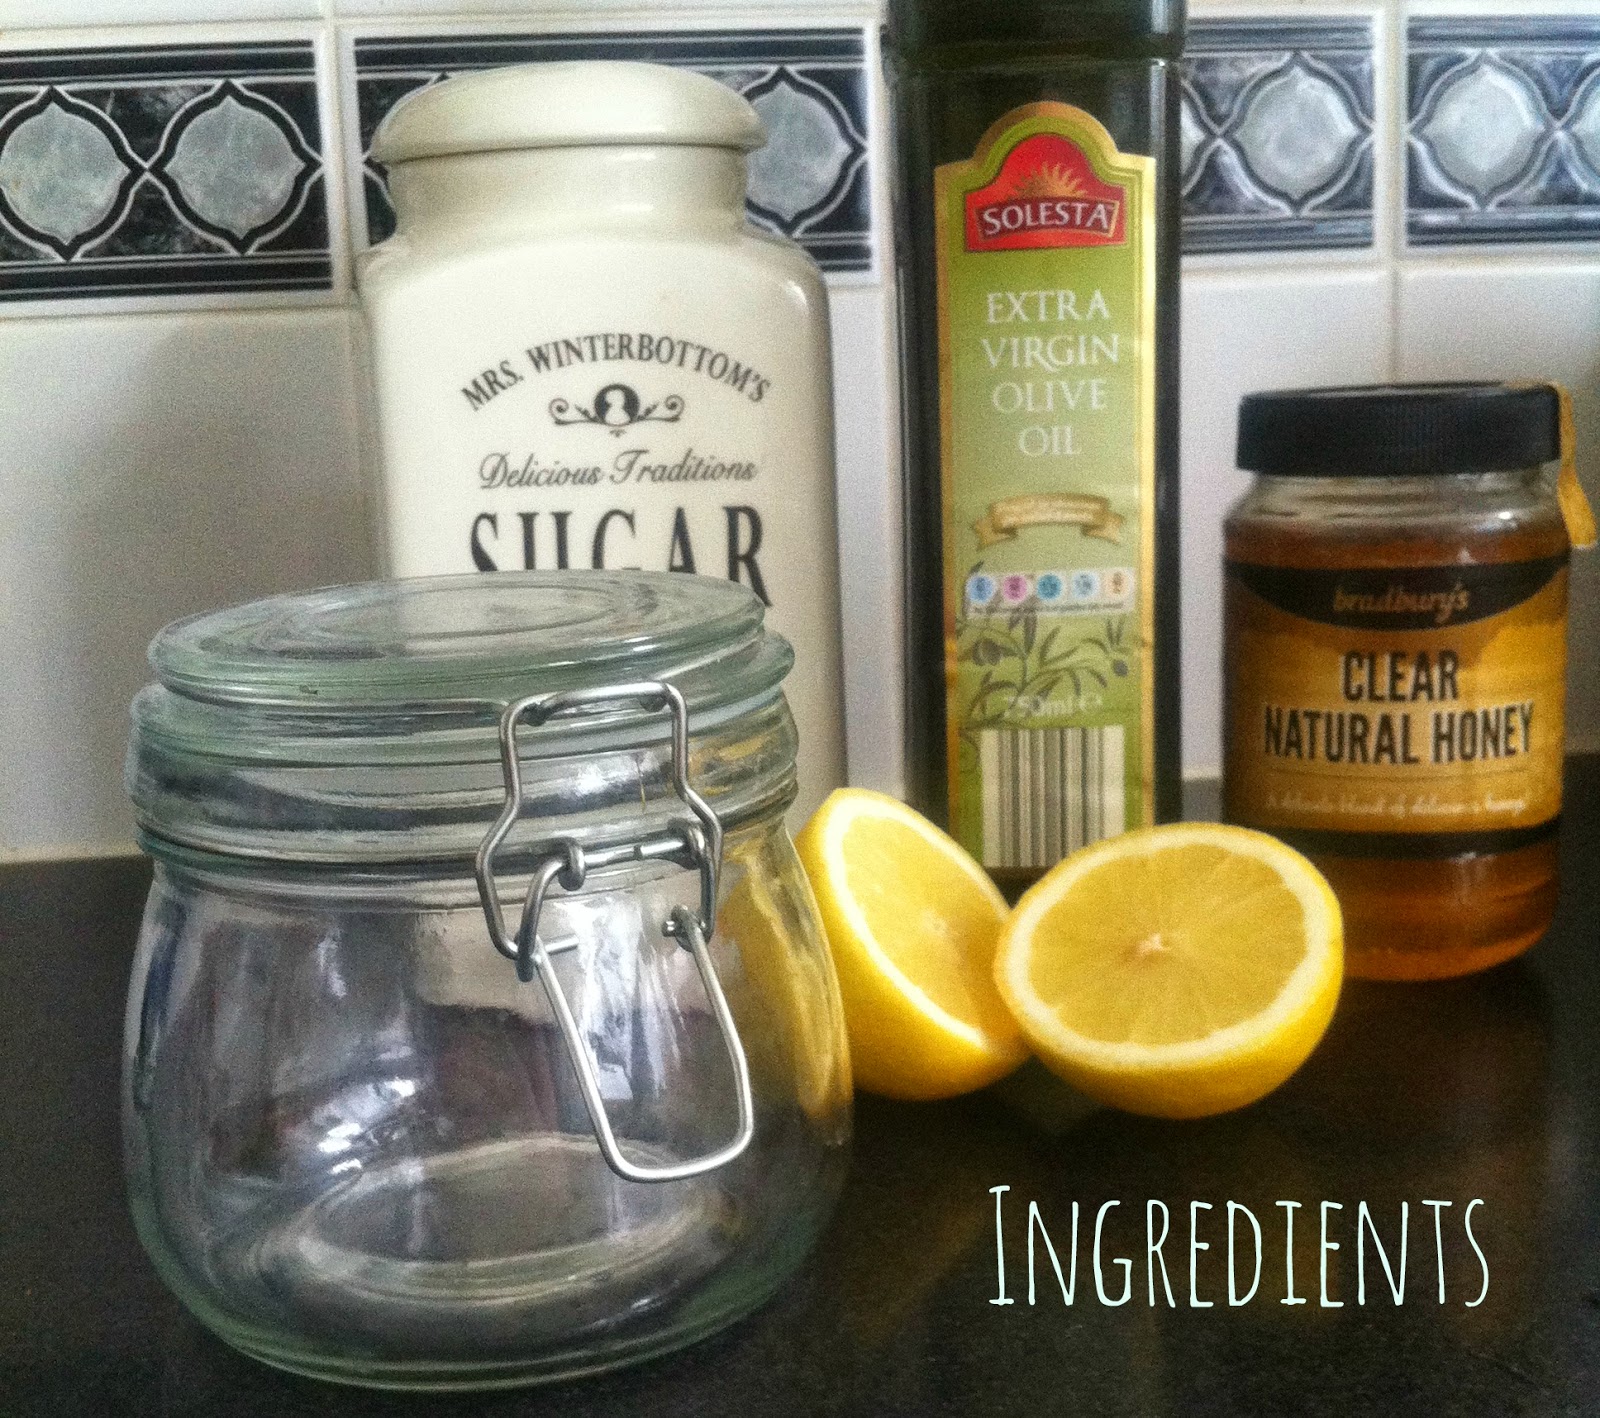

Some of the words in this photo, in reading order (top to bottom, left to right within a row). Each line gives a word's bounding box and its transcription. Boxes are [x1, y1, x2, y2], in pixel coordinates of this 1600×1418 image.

[982, 201, 1109, 236] SOLESTA
[985, 289, 1110, 324] EXTRA
[460, 360, 525, 412] MRS.
[525, 332, 772, 403] WINTERBOTTOM'S
[981, 333, 1119, 372] VIRGIN
[990, 379, 1108, 414] OLIVE
[1018, 425, 1079, 457] OIL
[478, 451, 602, 490] Delicious
[608, 447, 758, 485] Traditions
[1342, 650, 1460, 703] CLEAR
[1264, 704, 1420, 766] NATURAL
[1431, 700, 1536, 764] HONEY
